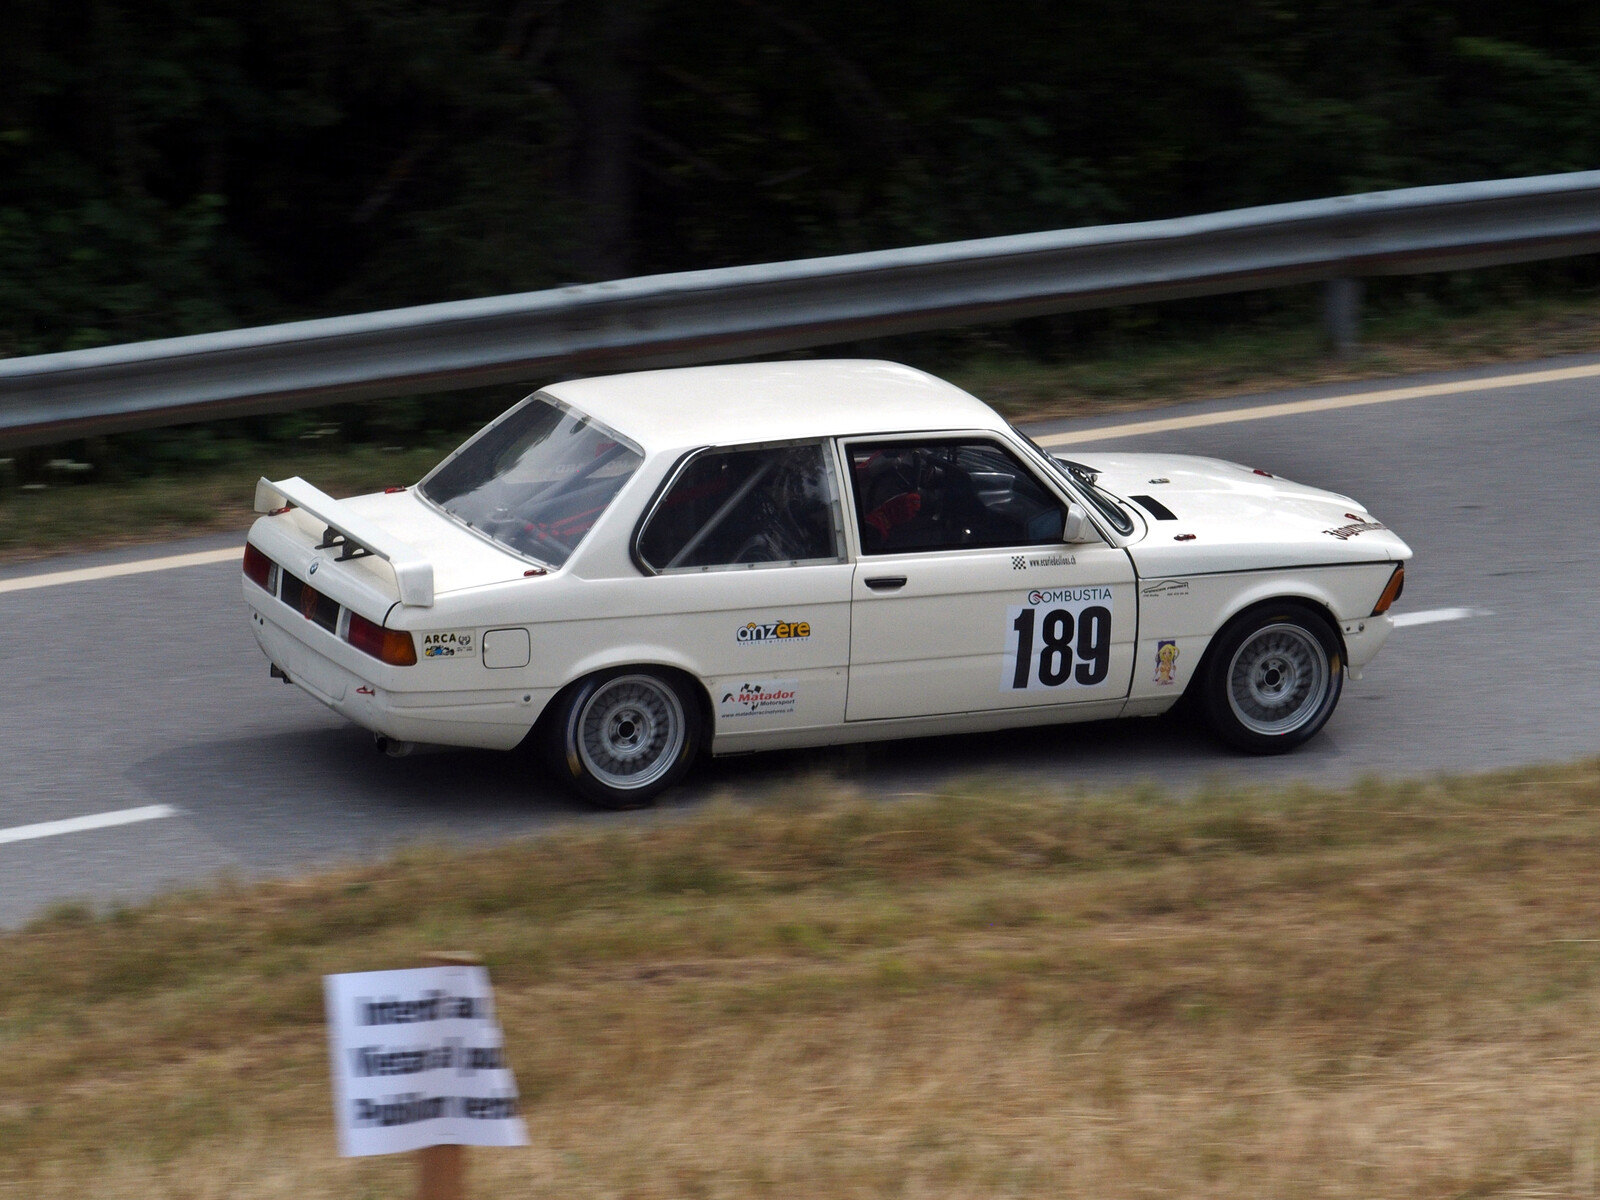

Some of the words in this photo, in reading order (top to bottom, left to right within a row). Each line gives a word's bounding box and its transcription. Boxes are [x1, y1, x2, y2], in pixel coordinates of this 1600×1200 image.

[1027, 588, 1113, 605] COMBUSTIA
[424, 633, 457, 644] ARCA
[1012, 605, 1112, 689] 189
[738, 690, 796, 702] Matador
[759, 699, 795, 707] Motorsport
